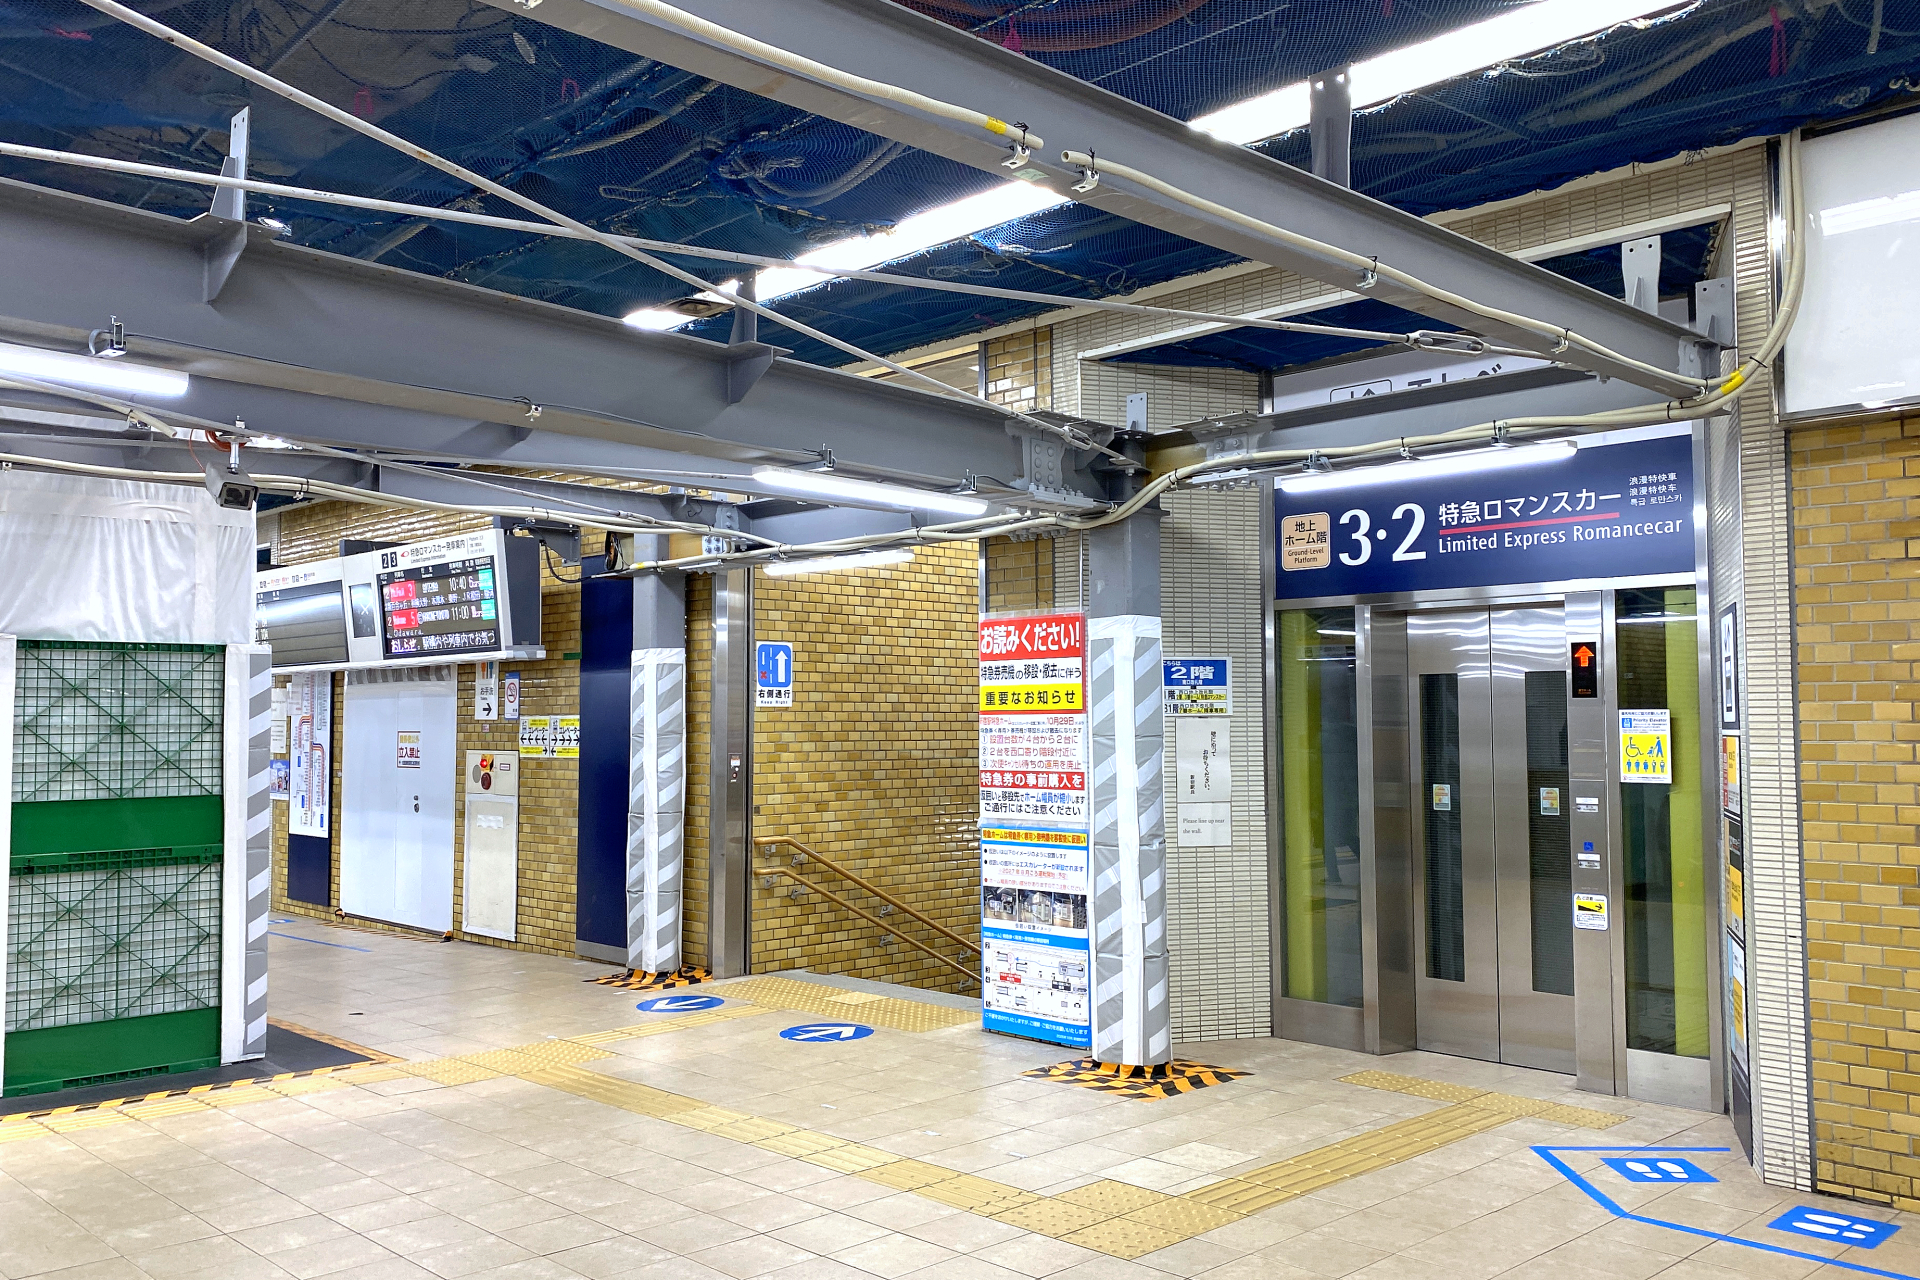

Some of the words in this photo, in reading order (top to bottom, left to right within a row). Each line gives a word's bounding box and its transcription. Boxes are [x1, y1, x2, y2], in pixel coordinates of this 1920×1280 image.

[1629, 472, 1677, 486] 浪漫特快車
[1629, 483, 1677, 497] 浪漫特快车
[1649, 493, 1683, 506] 로만스카
[1438, 488, 1622, 527] 特急ロマンスカー
[1294, 519, 1316, 533] 地上
[1285, 530, 1327, 546] ホーム階
[1438, 532, 1498, 554] Limited
[1504, 527, 1566, 550] Express
[1573, 518, 1682, 542] Romancecar
[1287, 547, 1324, 557] Ground-Level
[1294, 556, 1318, 564] Platform
[449, 576, 467, 591] 10:40
[411, 612, 415, 625] 5
[451, 605, 469, 620] 11:00
[980, 621, 1080, 654] お読みください!
[981, 663, 1082, 680] 特急券売機の移設・撤去に伴う
[1170, 665, 1215, 680] 2階
[758, 689, 791, 699] 右側通行
[985, 690, 1076, 706] 重要なお知らせ
[398, 747, 420, 759] 立入禁止
[981, 772, 1083, 788] 特急券の事前購入を
[984, 802, 1081, 815] ご通行にはご注意ください
